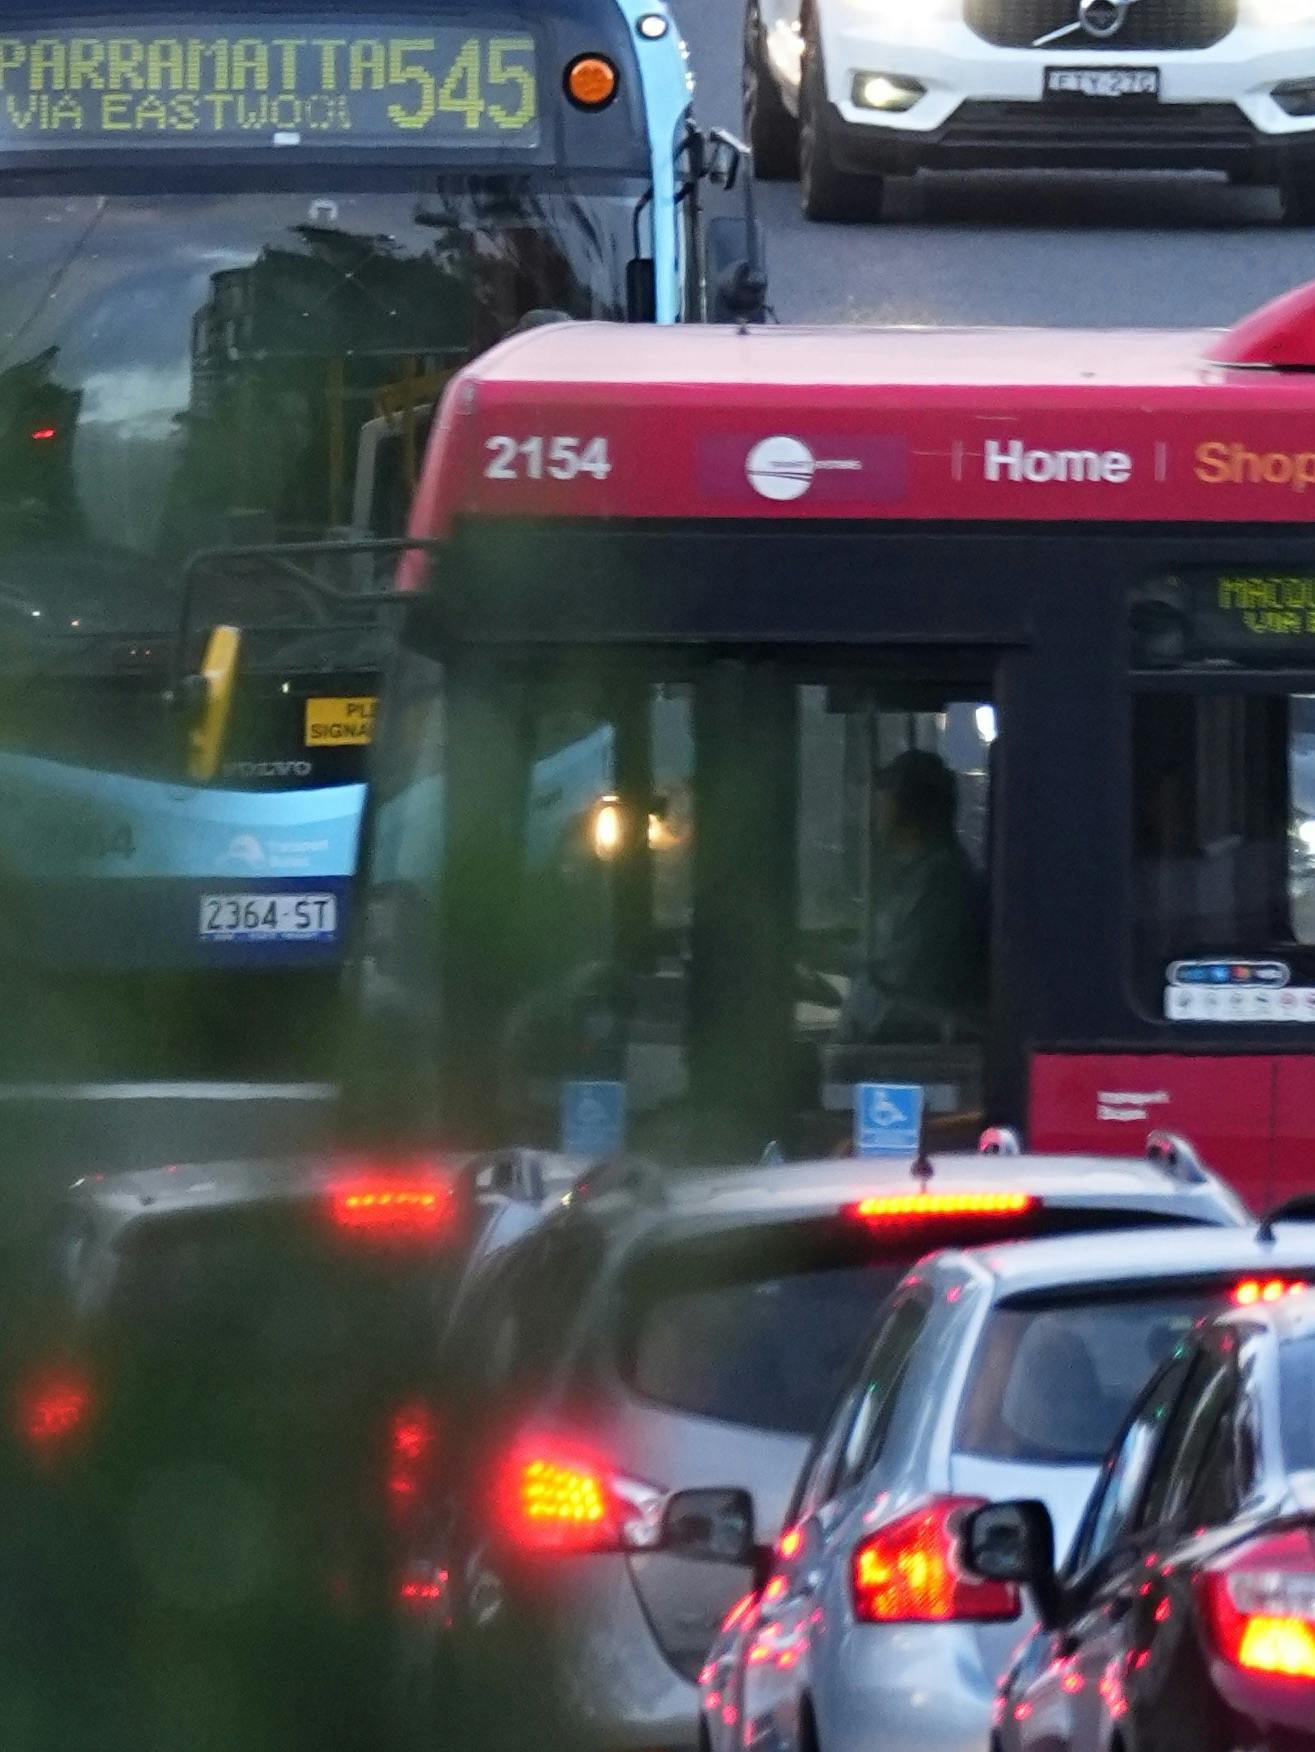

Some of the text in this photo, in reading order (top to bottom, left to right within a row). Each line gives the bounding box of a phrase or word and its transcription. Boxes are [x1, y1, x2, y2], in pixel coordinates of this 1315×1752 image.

[0, 38, 537, 130] PARRAMATTA 545
[6, 93, 84, 130] VIA
[484, 435, 612, 482] 2154
[984, 439, 1132, 484] Home
